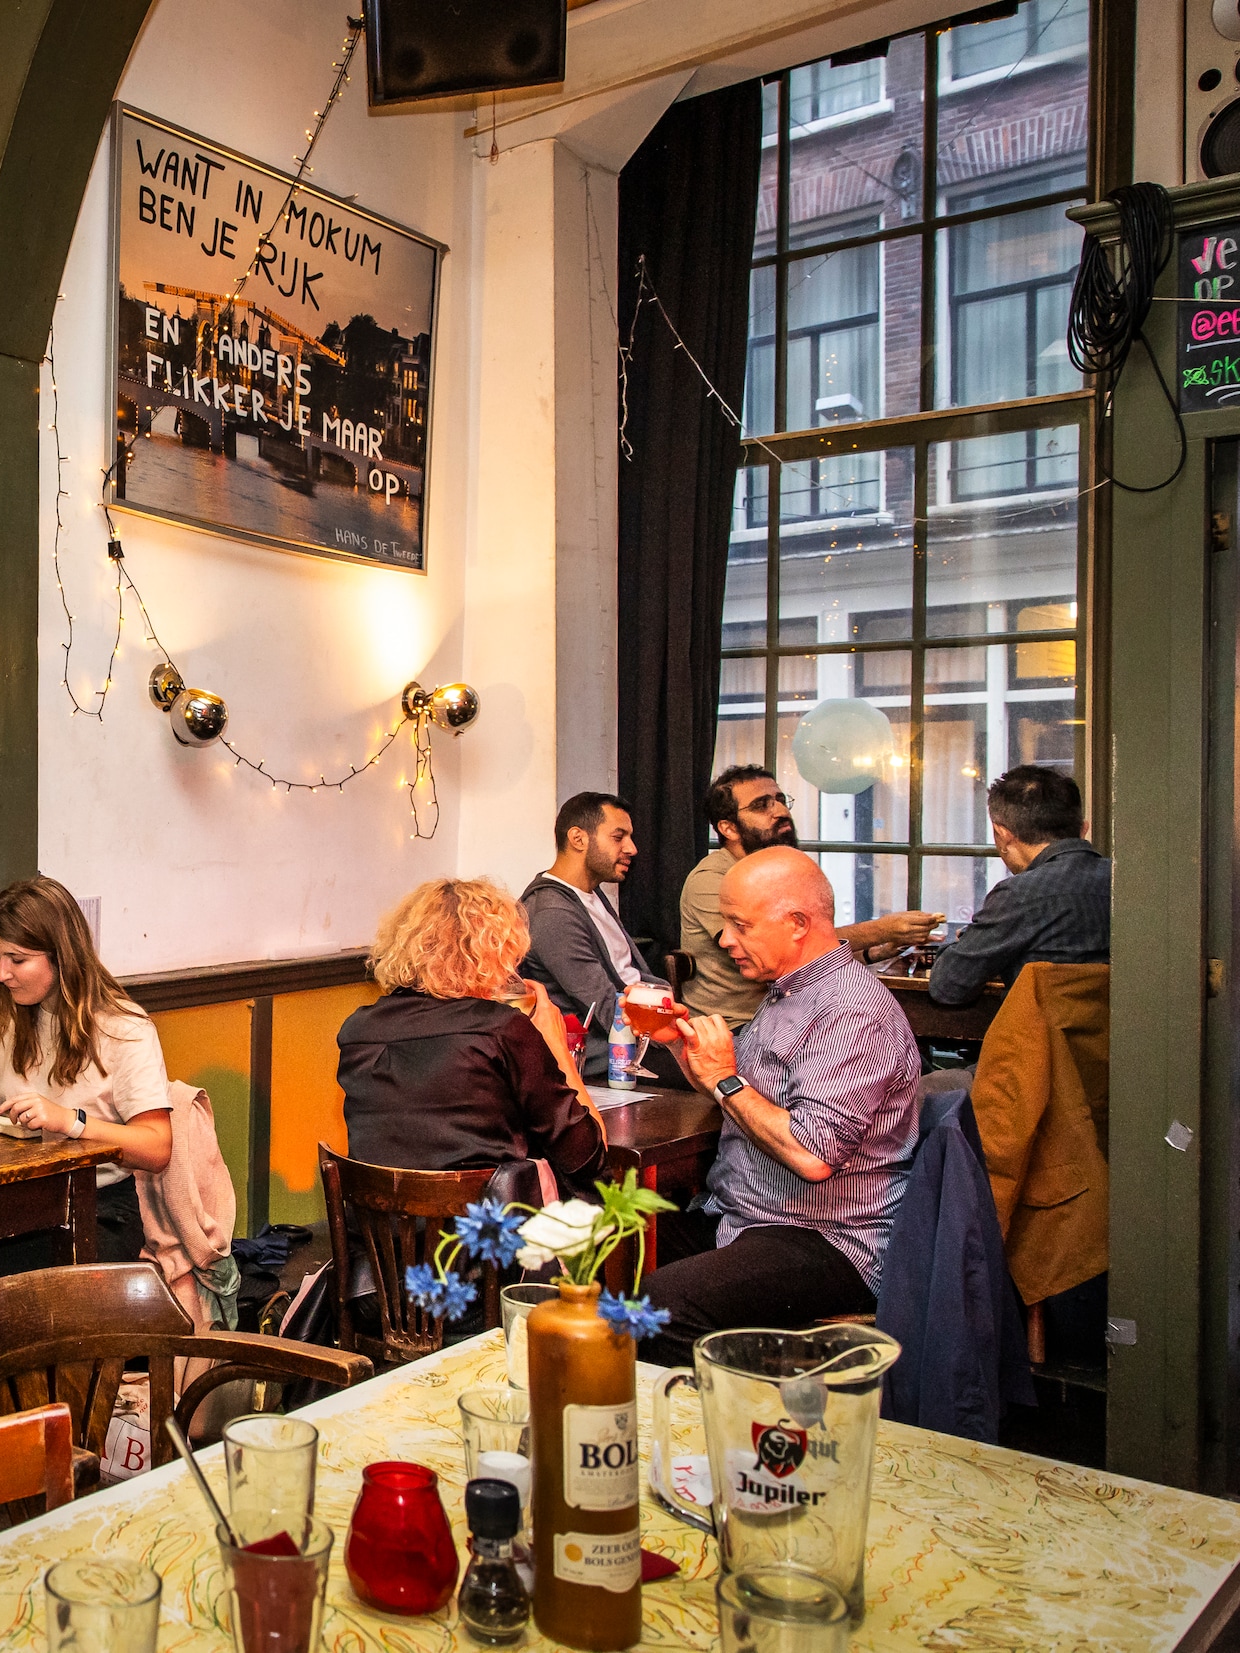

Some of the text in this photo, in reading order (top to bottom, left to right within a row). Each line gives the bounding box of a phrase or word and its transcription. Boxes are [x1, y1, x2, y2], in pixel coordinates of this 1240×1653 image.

[137, 139, 382, 276] WANT IN MOKUM
[139, 184, 324, 312] BEN JE RIJK
[145, 307, 312, 396] EN ANDERS
[145, 352, 384, 460] FLIKKER JE MAAR
[368, 468, 400, 505] OP
[335, 527, 368, 550] HANS
[373, 539, 388, 555] DE
[736, 1471, 826, 1506] Jupiler
